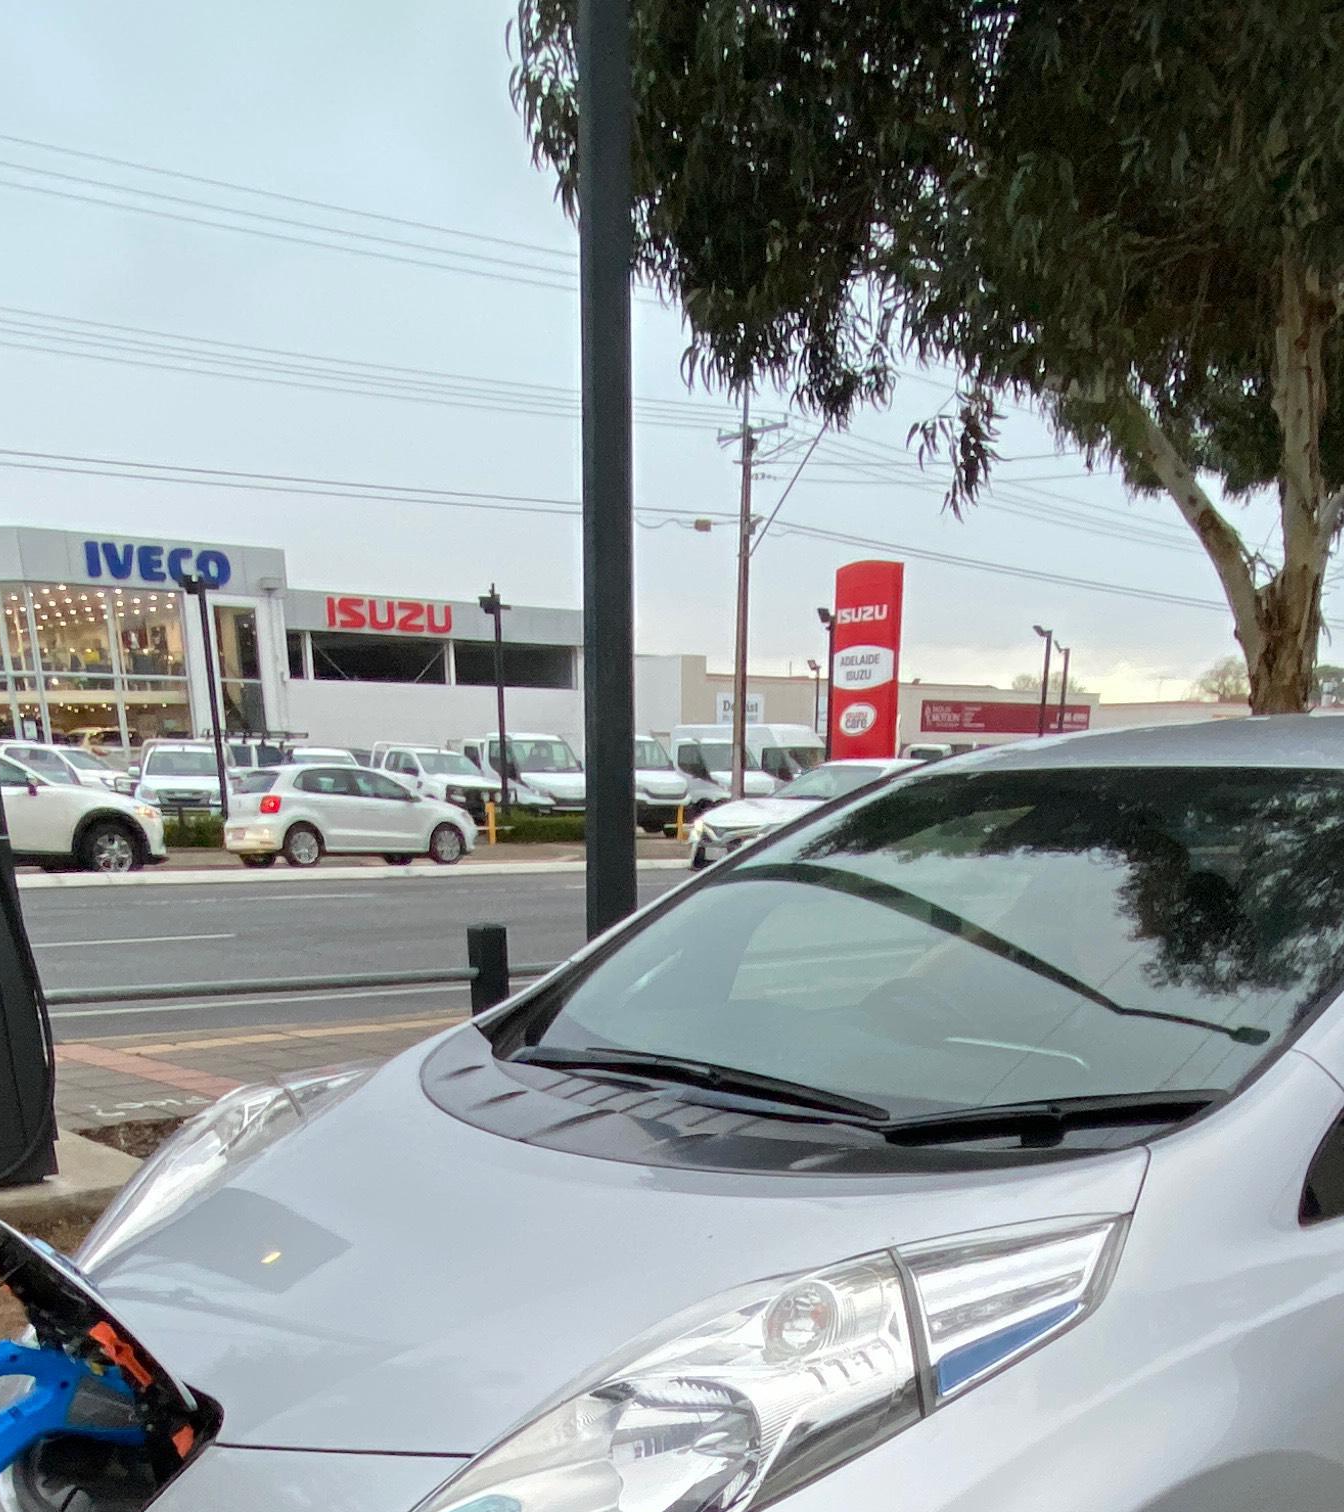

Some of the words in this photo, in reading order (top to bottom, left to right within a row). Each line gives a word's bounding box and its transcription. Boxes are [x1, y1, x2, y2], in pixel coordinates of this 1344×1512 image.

[84, 541, 231, 587] IVECO
[326, 596, 453, 634] ISUZU
[837, 604, 888, 624] ISUZU
[840, 653, 881, 667] ADELAIDE
[846, 669, 872, 682] ISUZU
